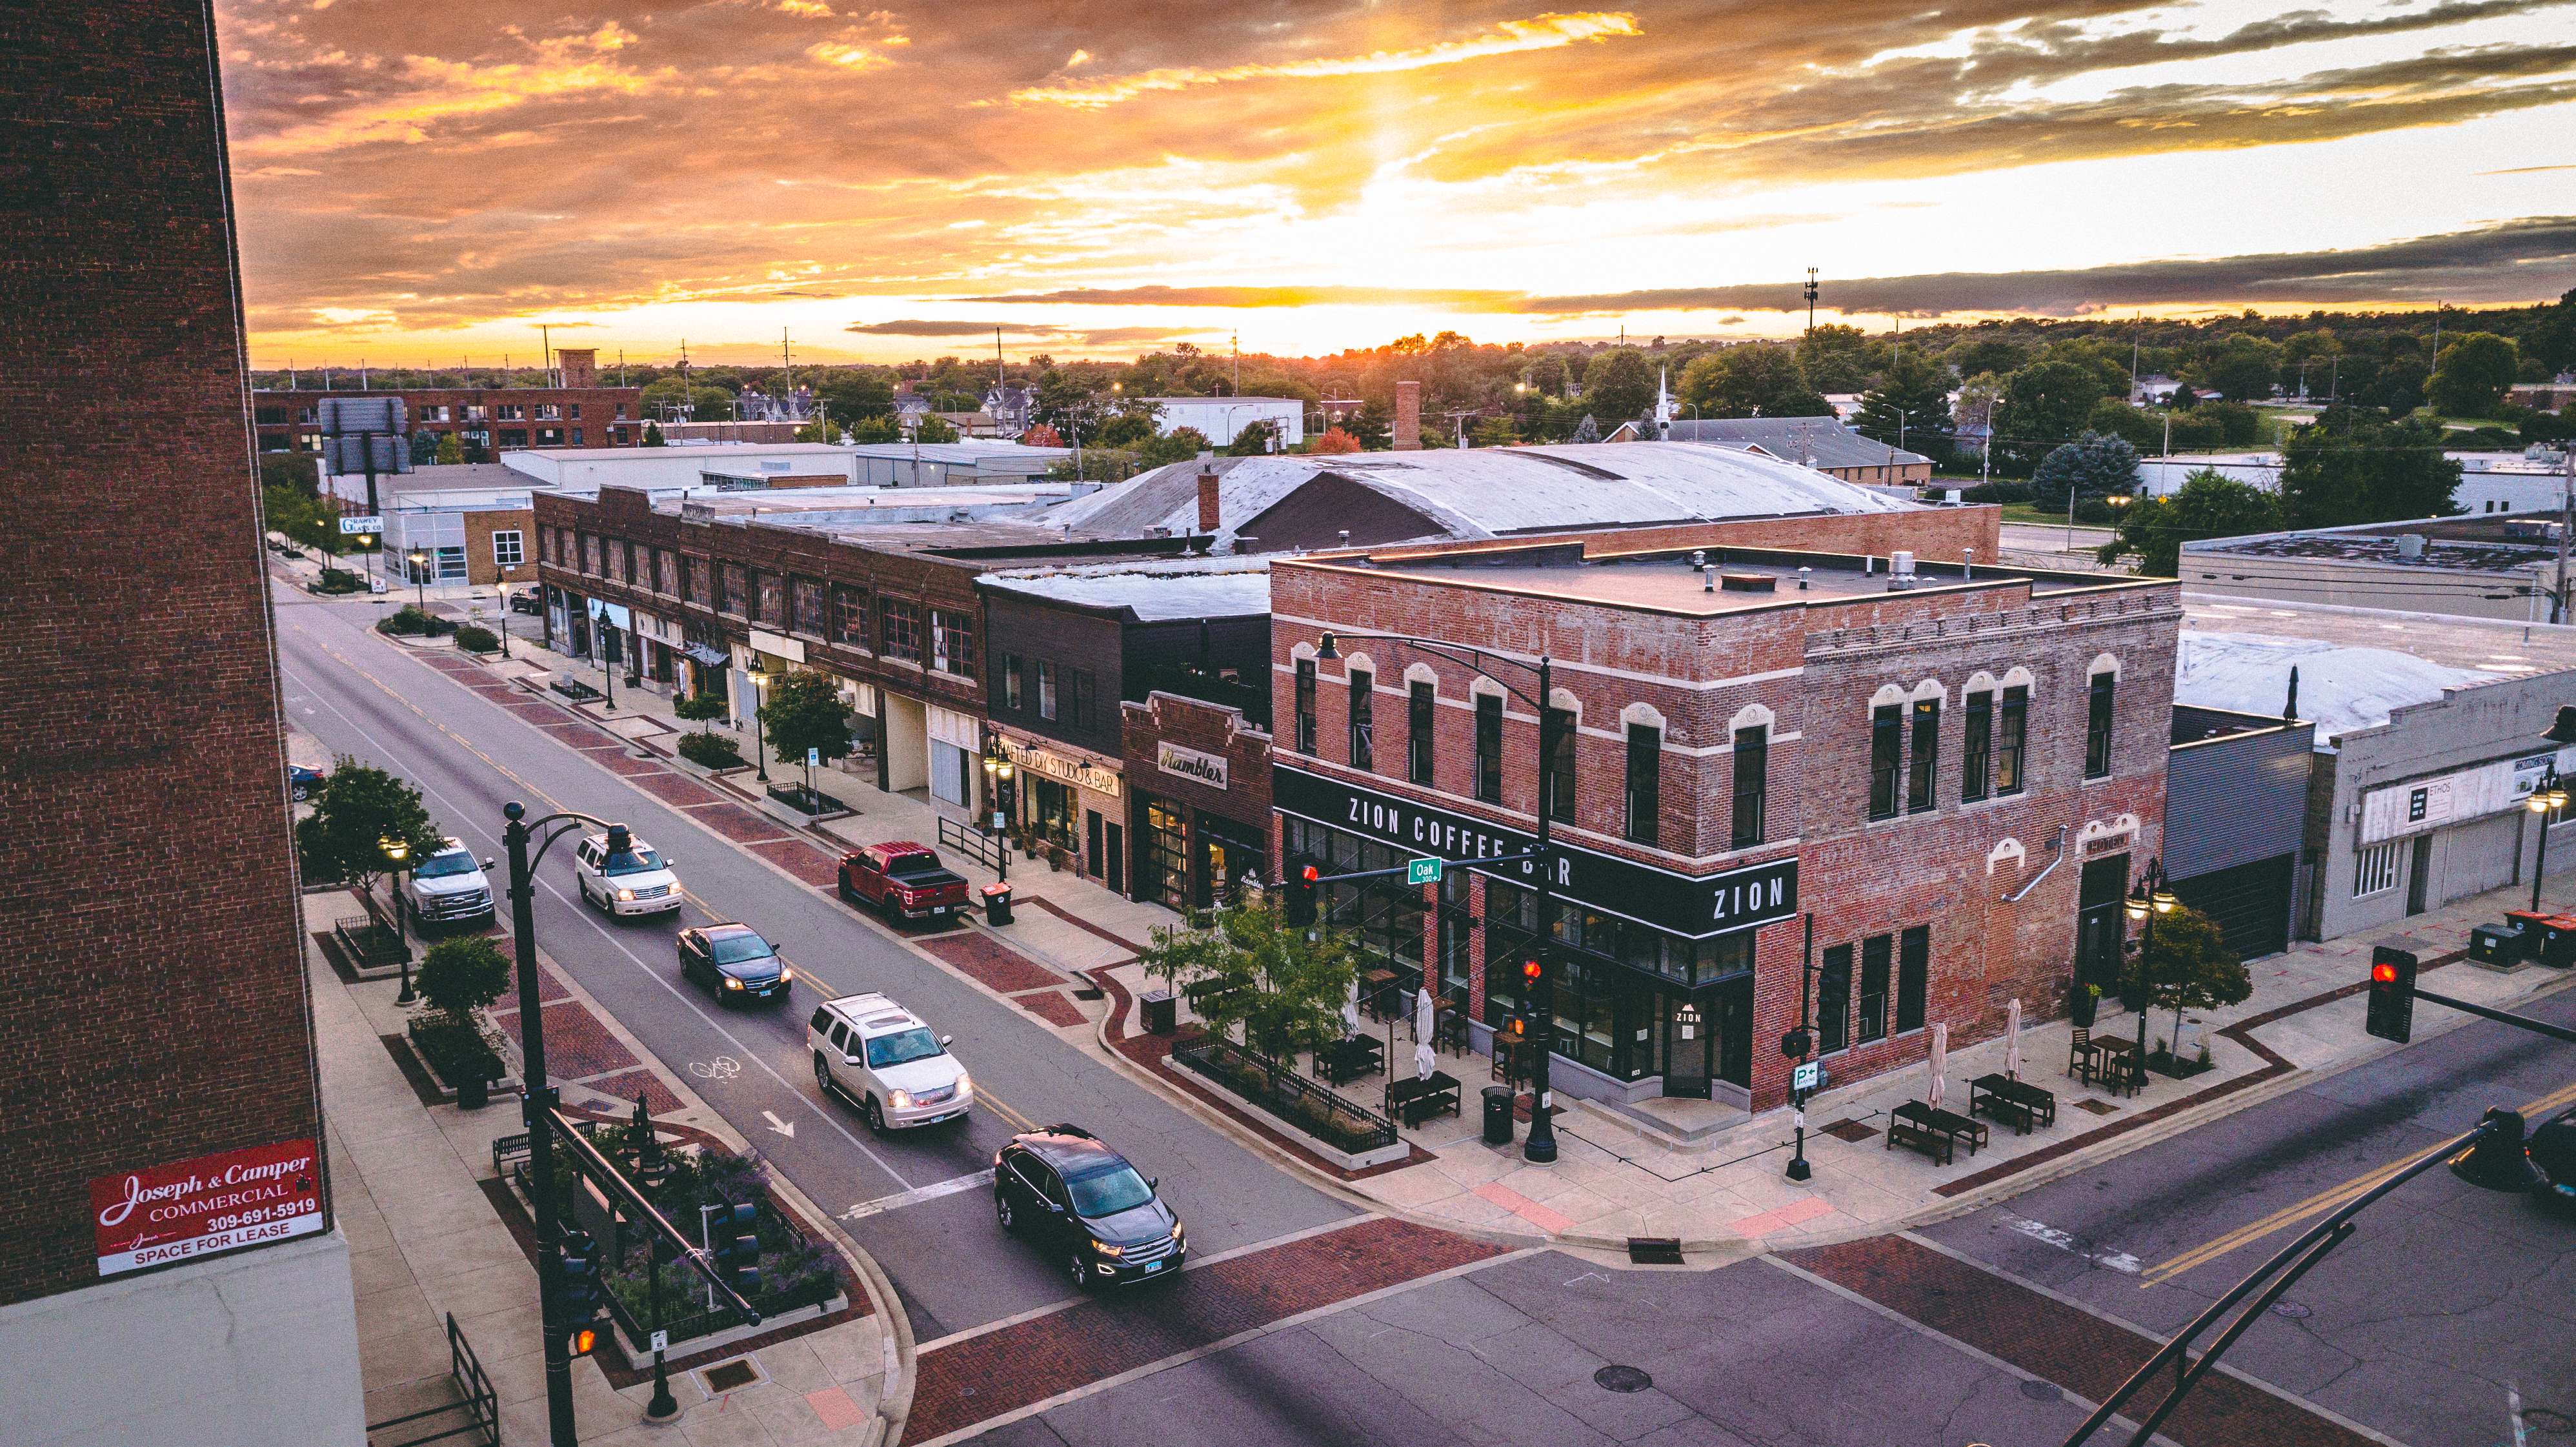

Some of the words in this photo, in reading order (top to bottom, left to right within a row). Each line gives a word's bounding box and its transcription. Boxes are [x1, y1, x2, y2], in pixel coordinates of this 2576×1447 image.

[1051, 758, 1083, 782] STUDIO
[1085, 769, 1092, 785] &
[1094, 771, 1113, 793] BAR
[1161, 748, 1223, 783] Rambler
[2430, 782, 2451, 796] ETHOS
[1349, 797, 1398, 835] ZION
[1414, 816, 1504, 865] COFFEE
[1523, 847, 1570, 886] BR
[2091, 835, 2124, 852] HOTEL
[1240, 875, 1265, 890] Rambler
[1416, 863, 1433, 876] Oak
[1714, 877, 1782, 920] ZION
[1676, 1013, 1701, 1022] ZION
[99, 1175, 203, 1226] Joseph
[208, 1177, 221, 1189] &
[225, 1156, 310, 1186] Camper
[150, 1184, 288, 1222] COMMERCIAL
[207, 1197, 316, 1233] 309-691-5919
[135, 1244, 192, 1264] SPACE
[197, 1235, 231, 1251] FOR
[236, 1223, 290, 1245] LEASE
